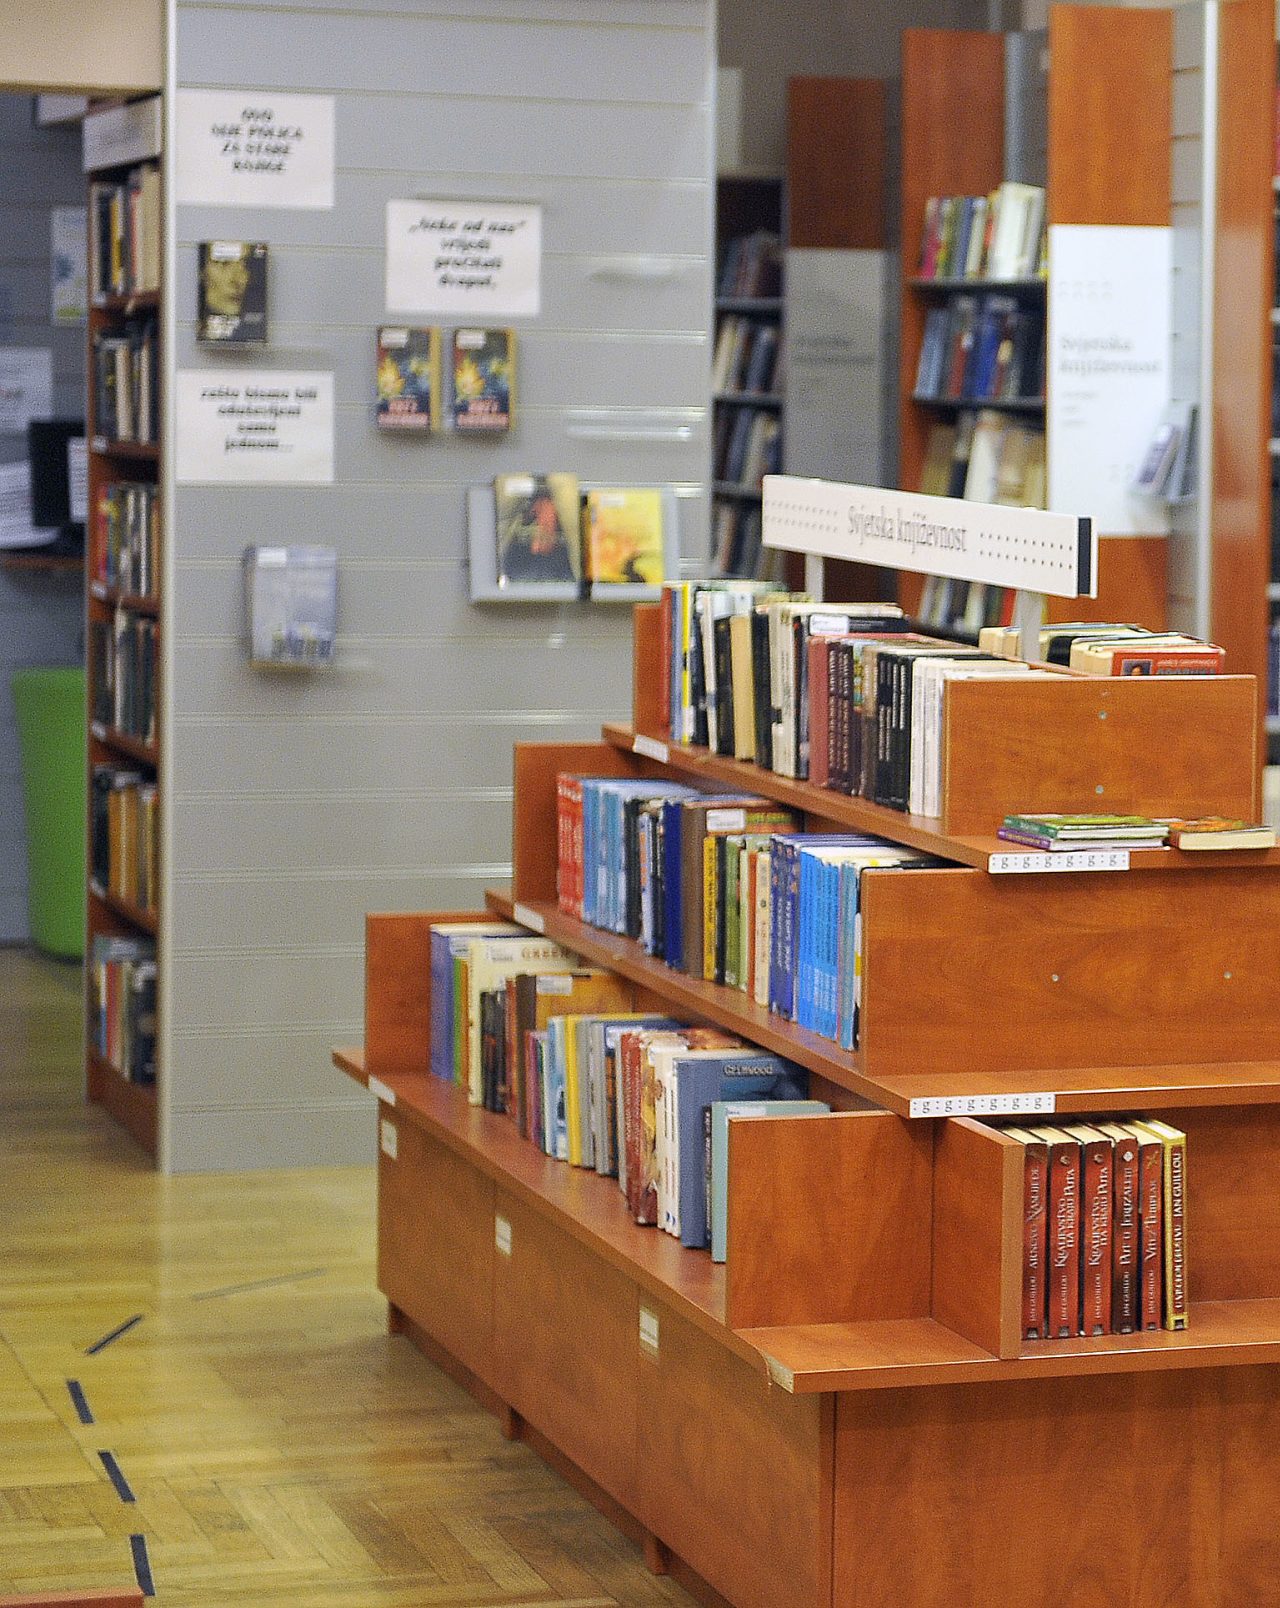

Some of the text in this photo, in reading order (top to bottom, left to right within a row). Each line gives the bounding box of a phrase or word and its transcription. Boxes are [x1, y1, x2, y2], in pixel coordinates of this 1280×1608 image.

[847, 504, 968, 554] Svjetska književnost
[1172, 1152, 1182, 1217] JAN GUILLOU
